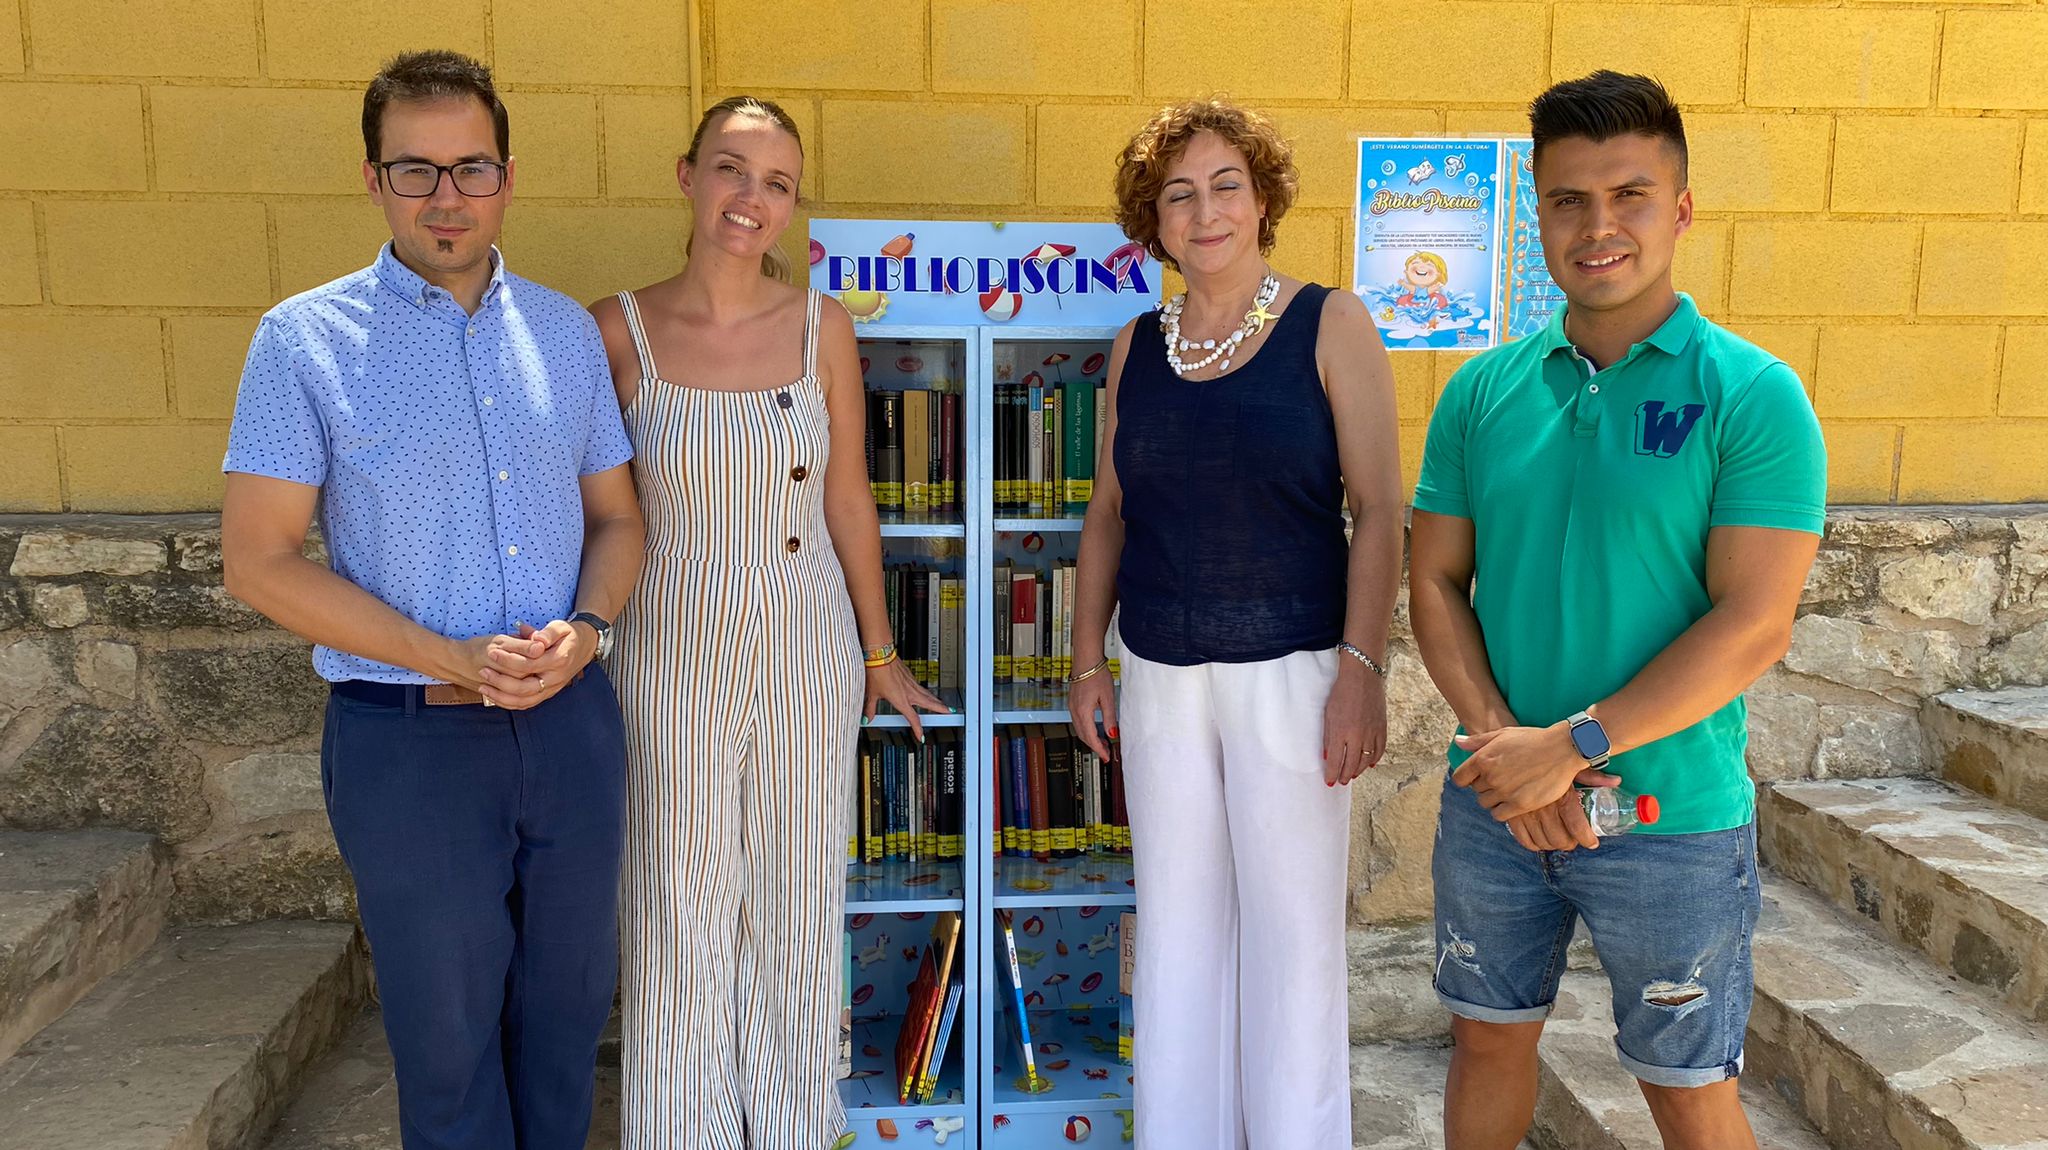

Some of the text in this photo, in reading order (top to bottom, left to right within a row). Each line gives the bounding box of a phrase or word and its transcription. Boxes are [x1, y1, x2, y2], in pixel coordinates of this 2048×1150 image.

[1386, 143, 1410, 151] VERANO
[1446, 143, 1454, 151] EN
[1454, 143, 1462, 151] LA
[828, 255, 1151, 295] BIBLIOPISCINA
[1031, 412, 1040, 449] SOSPECHOSOS
[1634, 400, 1705, 458] W
[944, 750, 954, 794] acosada
